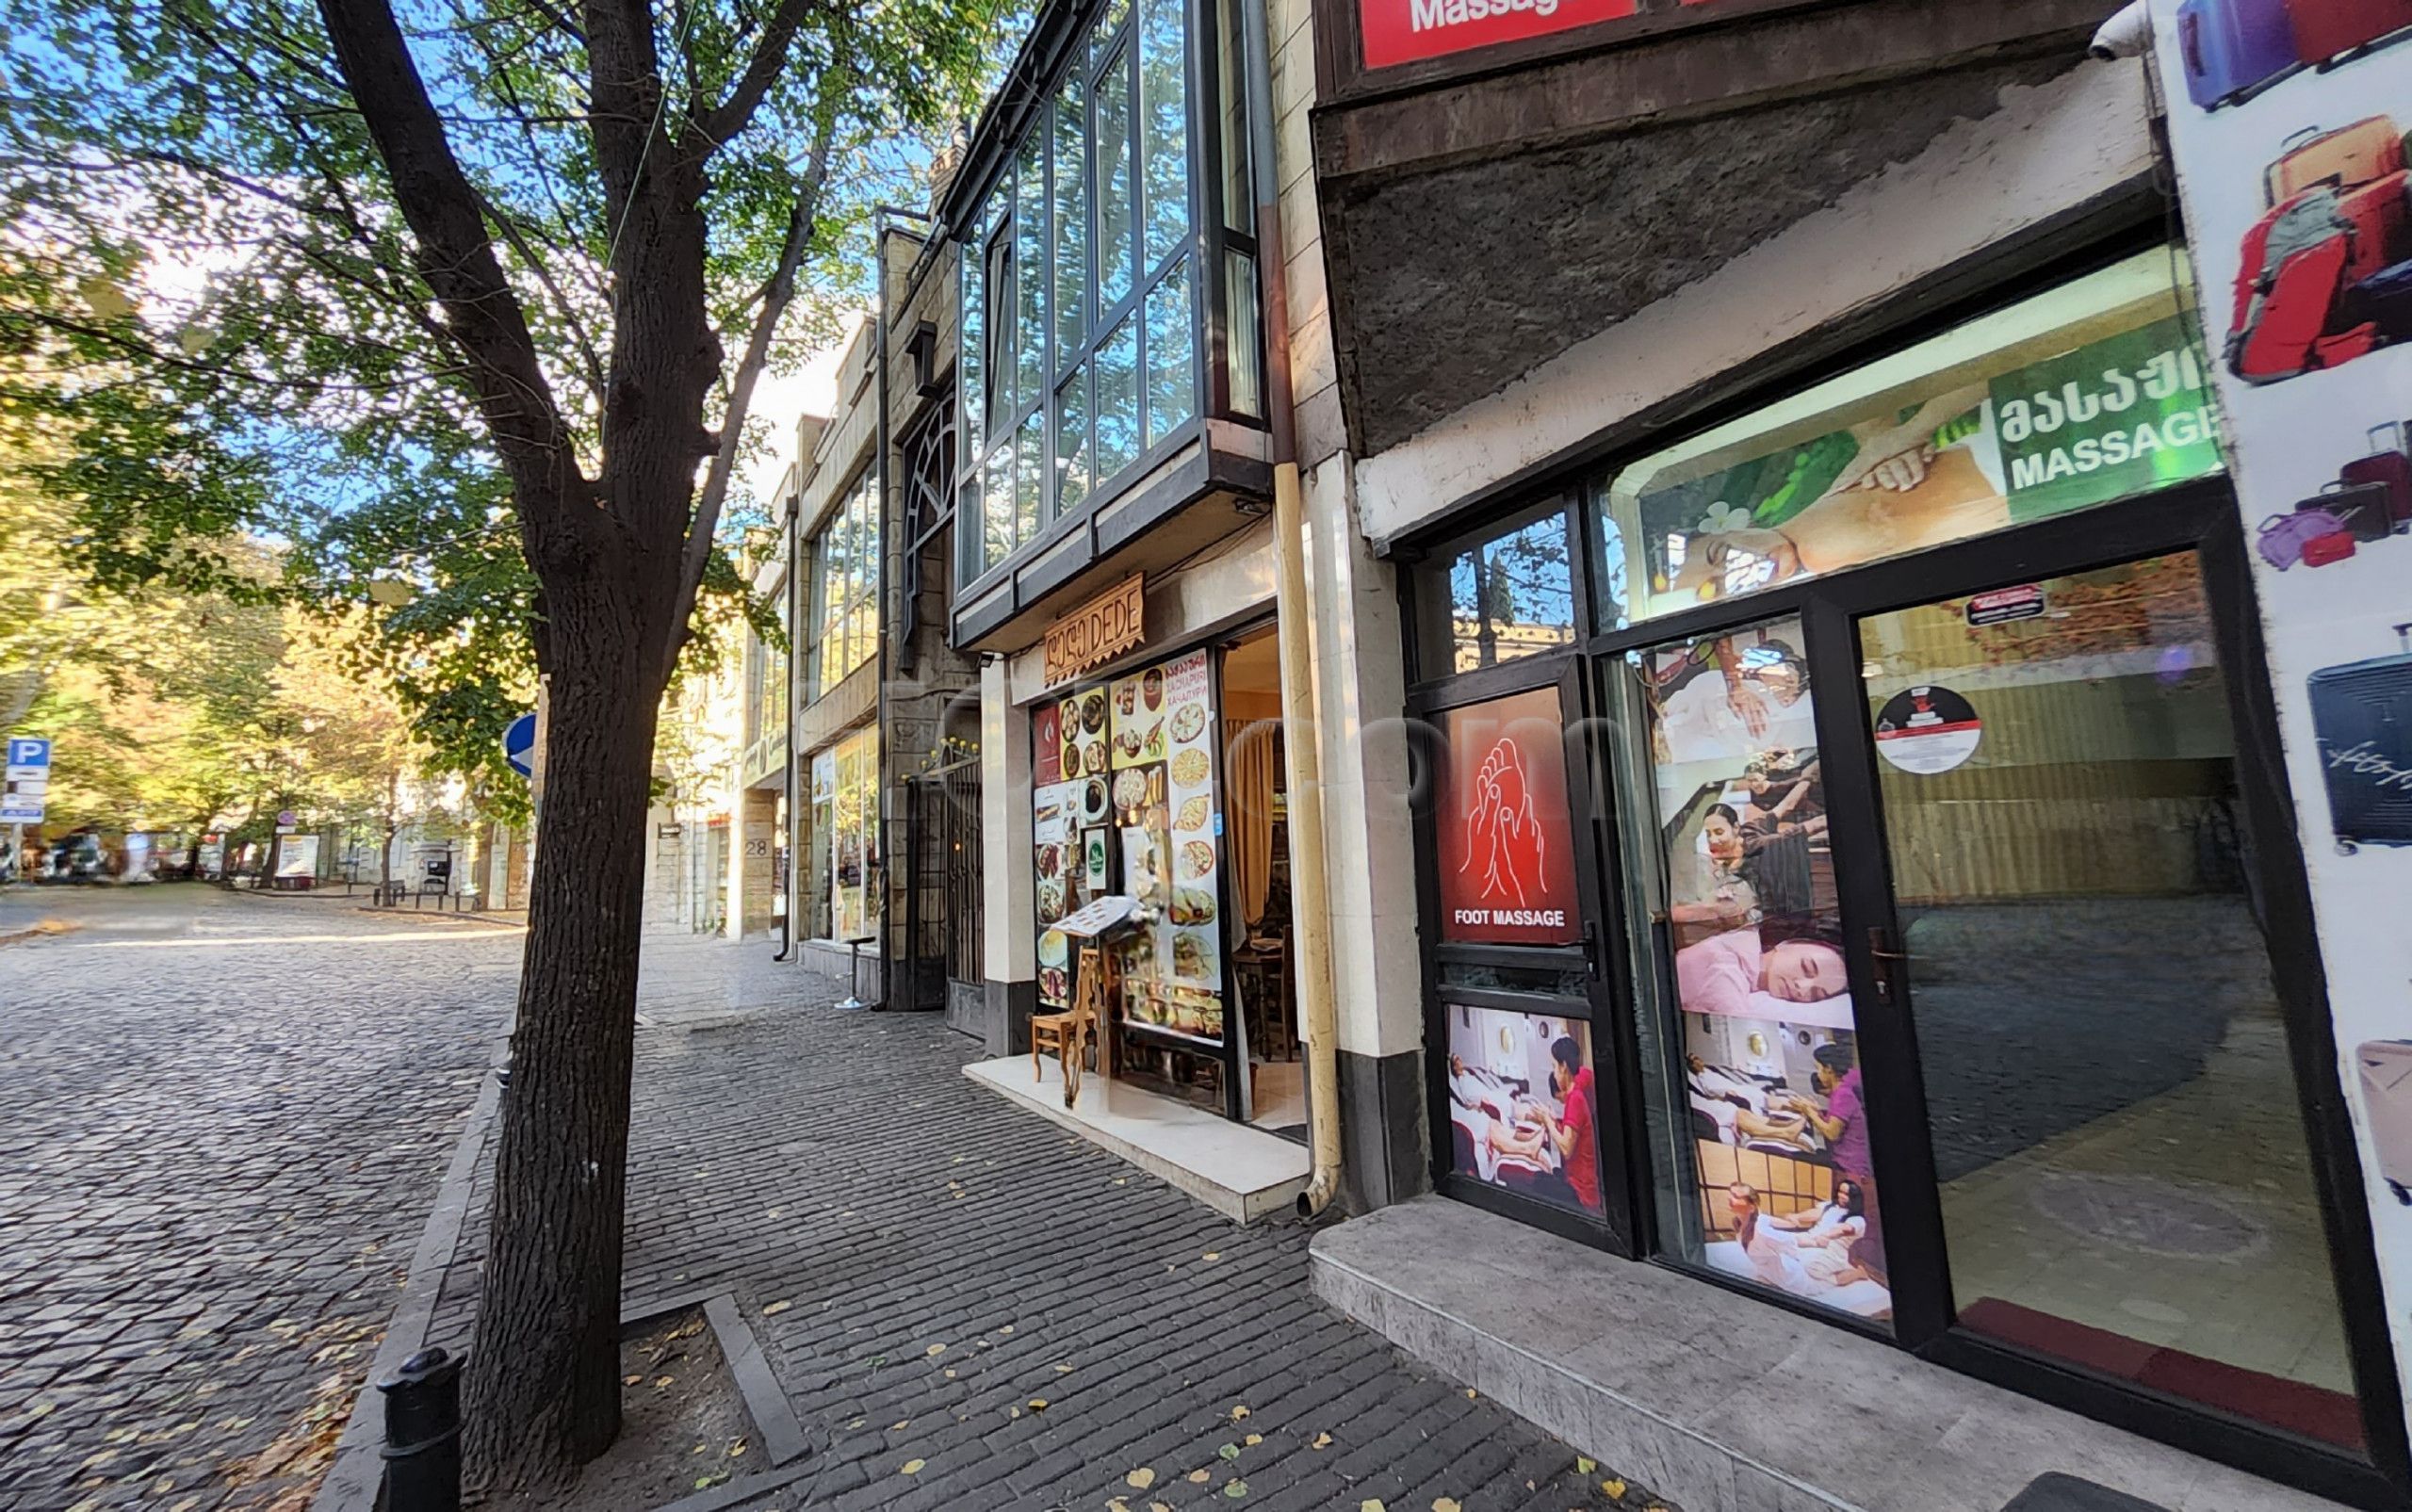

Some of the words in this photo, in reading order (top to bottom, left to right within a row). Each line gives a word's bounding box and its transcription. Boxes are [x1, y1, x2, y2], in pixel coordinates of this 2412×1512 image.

[2011, 403, 2222, 490] MASSAGE
[1091, 588, 1140, 652] DEDE
[16, 742, 42, 763] P
[745, 840, 767, 856] 28
[1455, 910, 1490, 925] FOOT
[1493, 910, 1565, 927] MASSAGE
